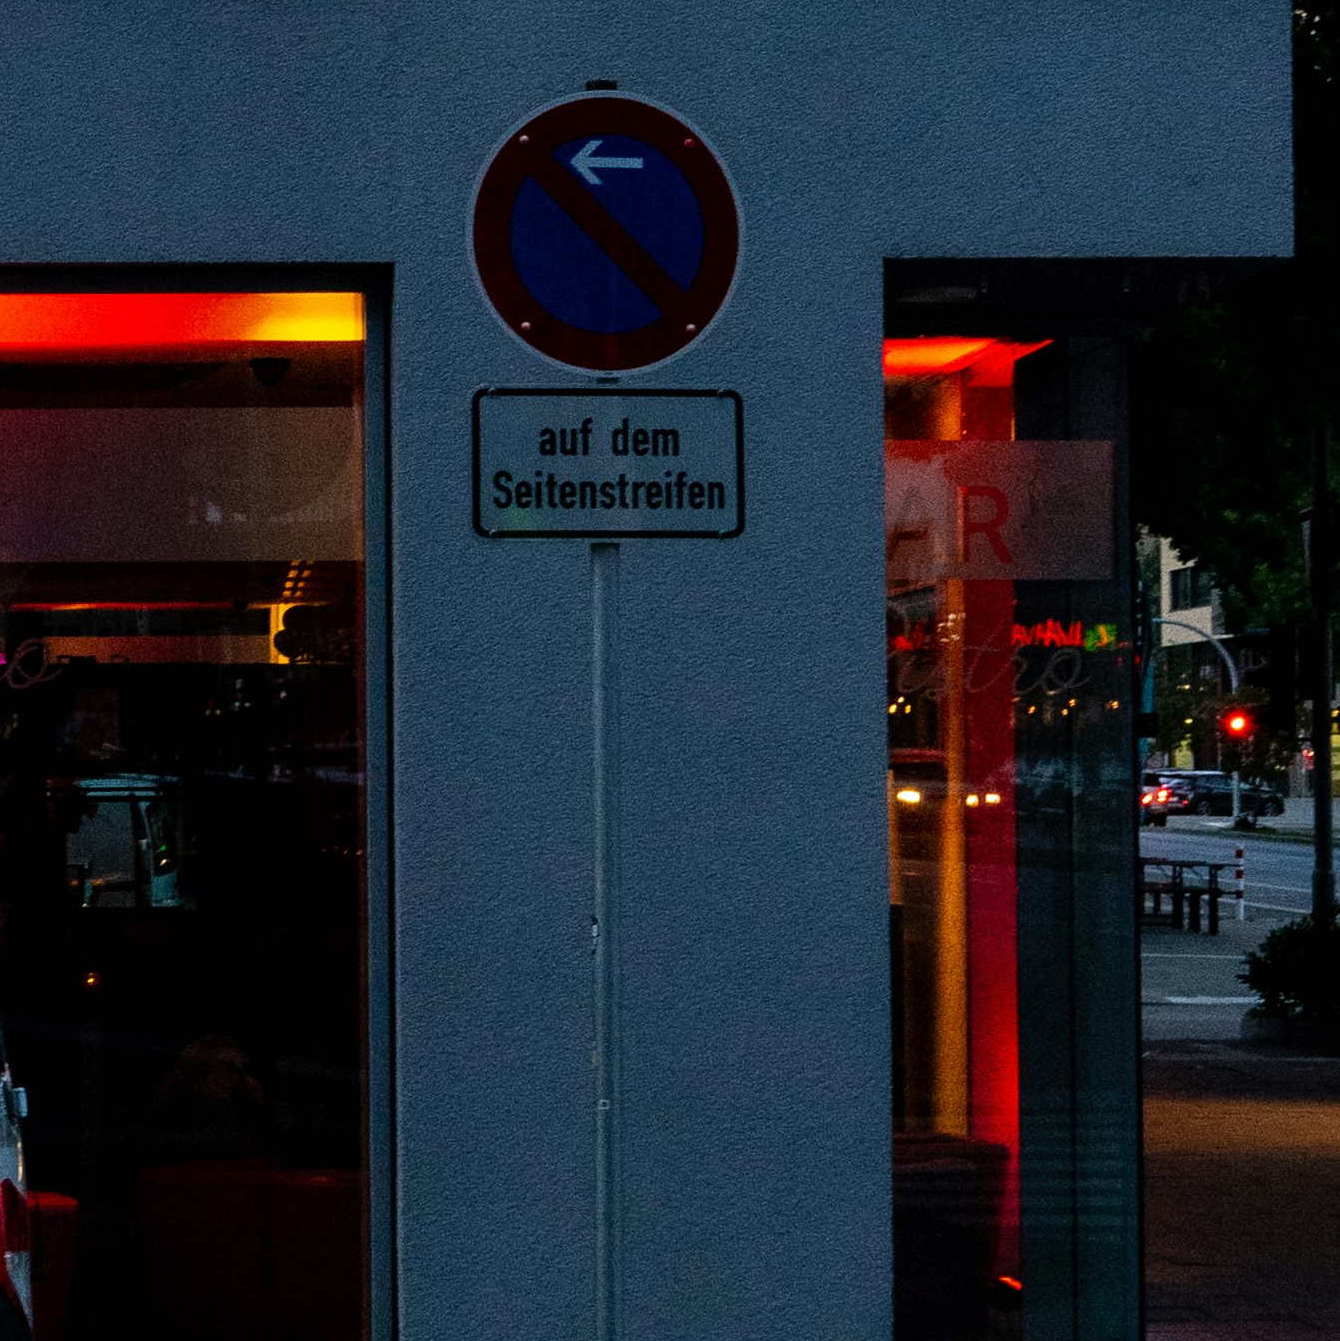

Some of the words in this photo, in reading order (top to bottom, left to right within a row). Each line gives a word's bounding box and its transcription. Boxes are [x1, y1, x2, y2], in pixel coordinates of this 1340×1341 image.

[539, 418, 593, 456] auf
[611, 418, 680, 456] dem
[492, 470, 726, 510] Seitenstreifen
